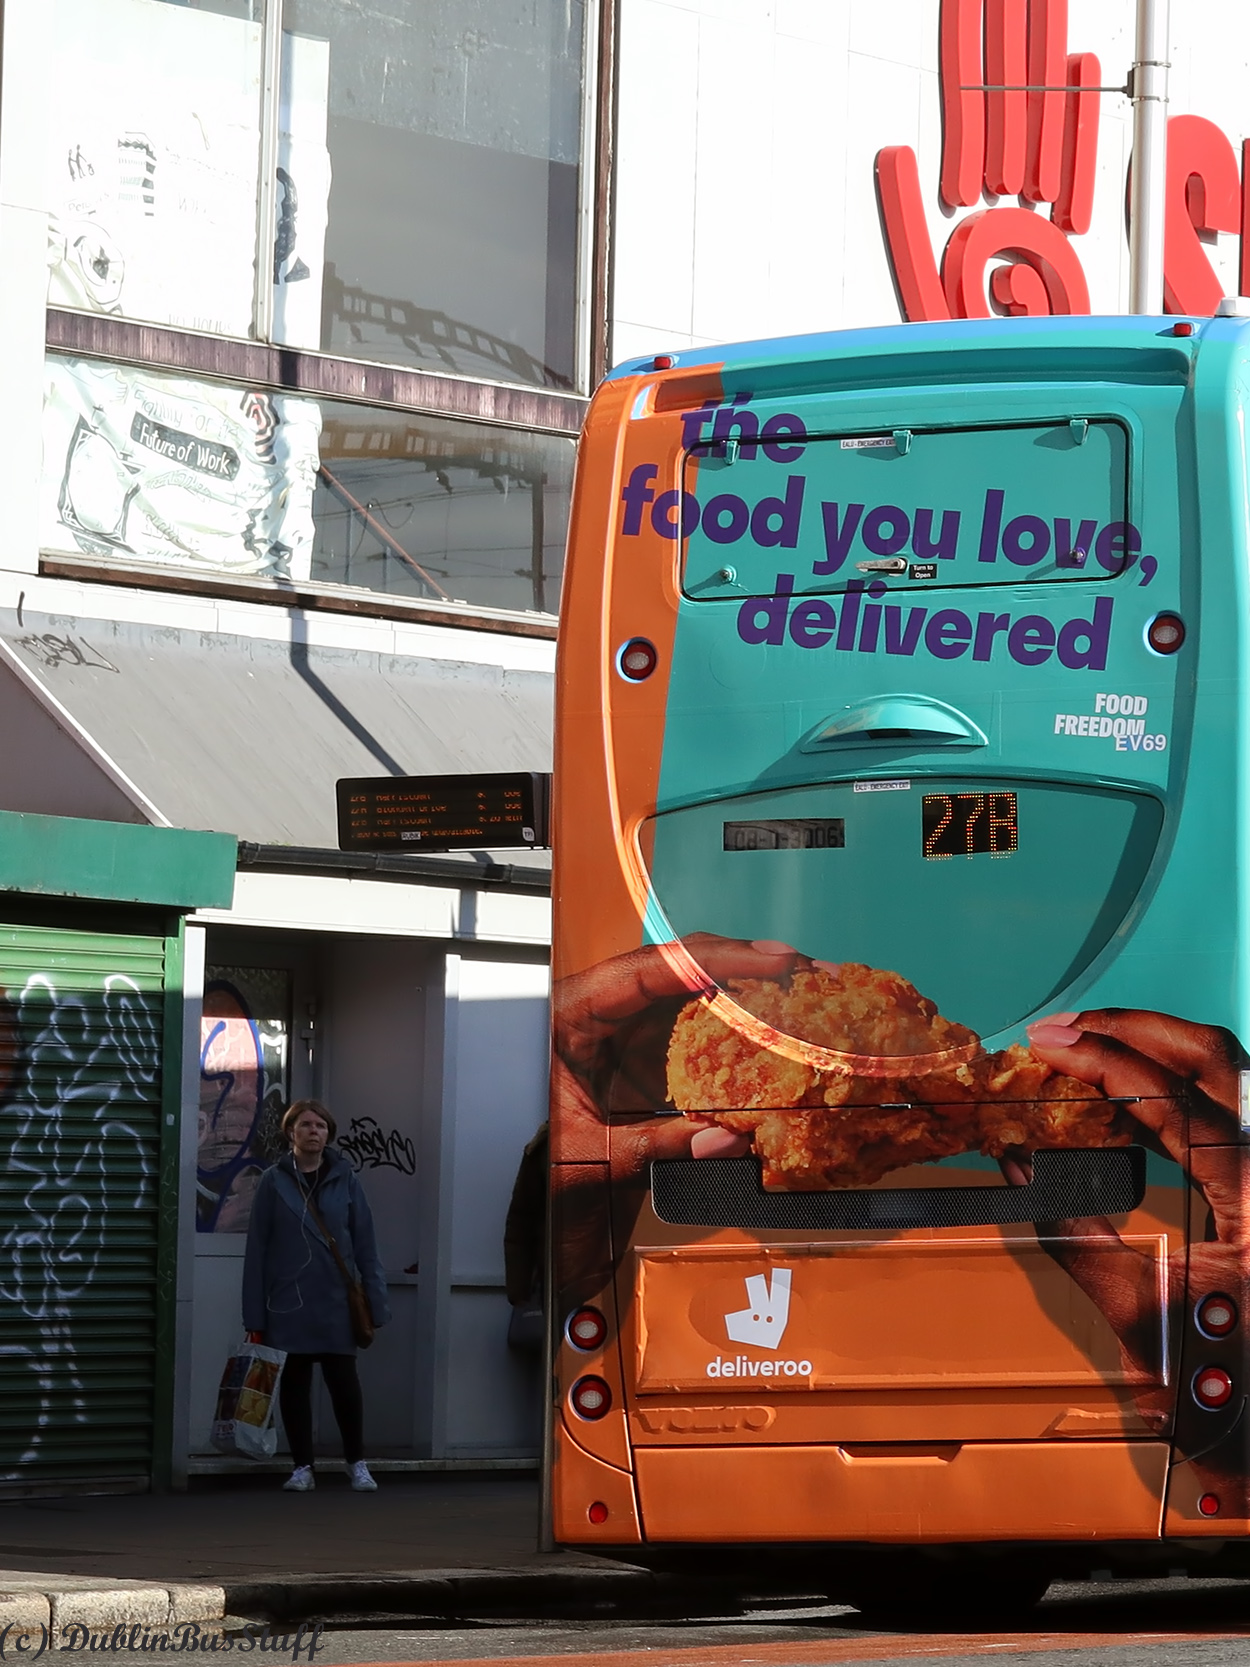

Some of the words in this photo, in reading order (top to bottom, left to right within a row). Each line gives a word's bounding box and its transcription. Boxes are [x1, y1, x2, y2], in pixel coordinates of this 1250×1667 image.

[681, 392, 808, 463] the
[139, 422, 176, 457] Future
[177, 441, 195, 462] of
[197, 444, 230, 475] Work
[622, 464, 806, 548] food
[812, 501, 960, 576] you
[978, 489, 1158, 587] love,
[737, 573, 1114, 671] delivered
[1095, 693, 1148, 716] FOOD
[1054, 714, 1146, 739] FREEDOM
[1115, 734, 1167, 751] EV69
[706, 1355, 813, 1378] deliveroo
